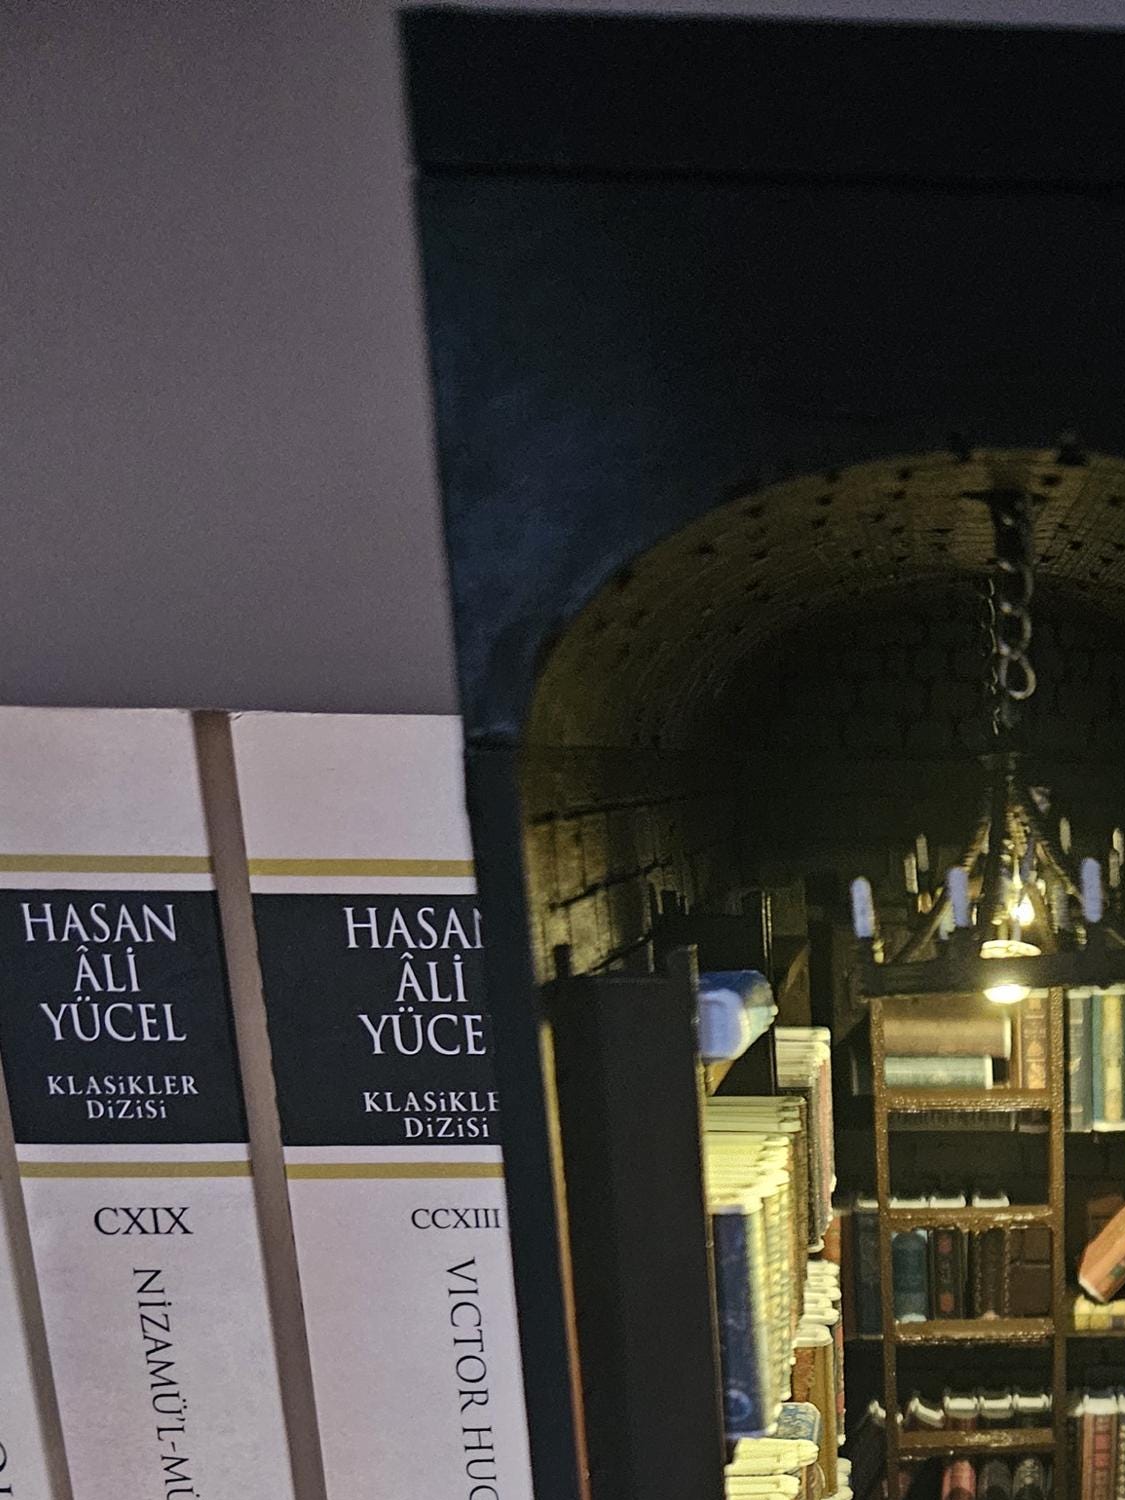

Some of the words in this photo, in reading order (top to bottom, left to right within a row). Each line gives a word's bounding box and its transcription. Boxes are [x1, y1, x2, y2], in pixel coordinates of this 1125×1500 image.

[21, 902, 177, 943] HASAN
[73, 944, 140, 993] ÂLİ
[395, 951, 468, 1003] ÂLİ
[39, 995, 187, 1042] YÜCEL
[357, 1006, 487, 1055] YÜCE
[93, 1206, 194, 1236] CXIX
[446, 1258, 489, 1413] VICTOR
